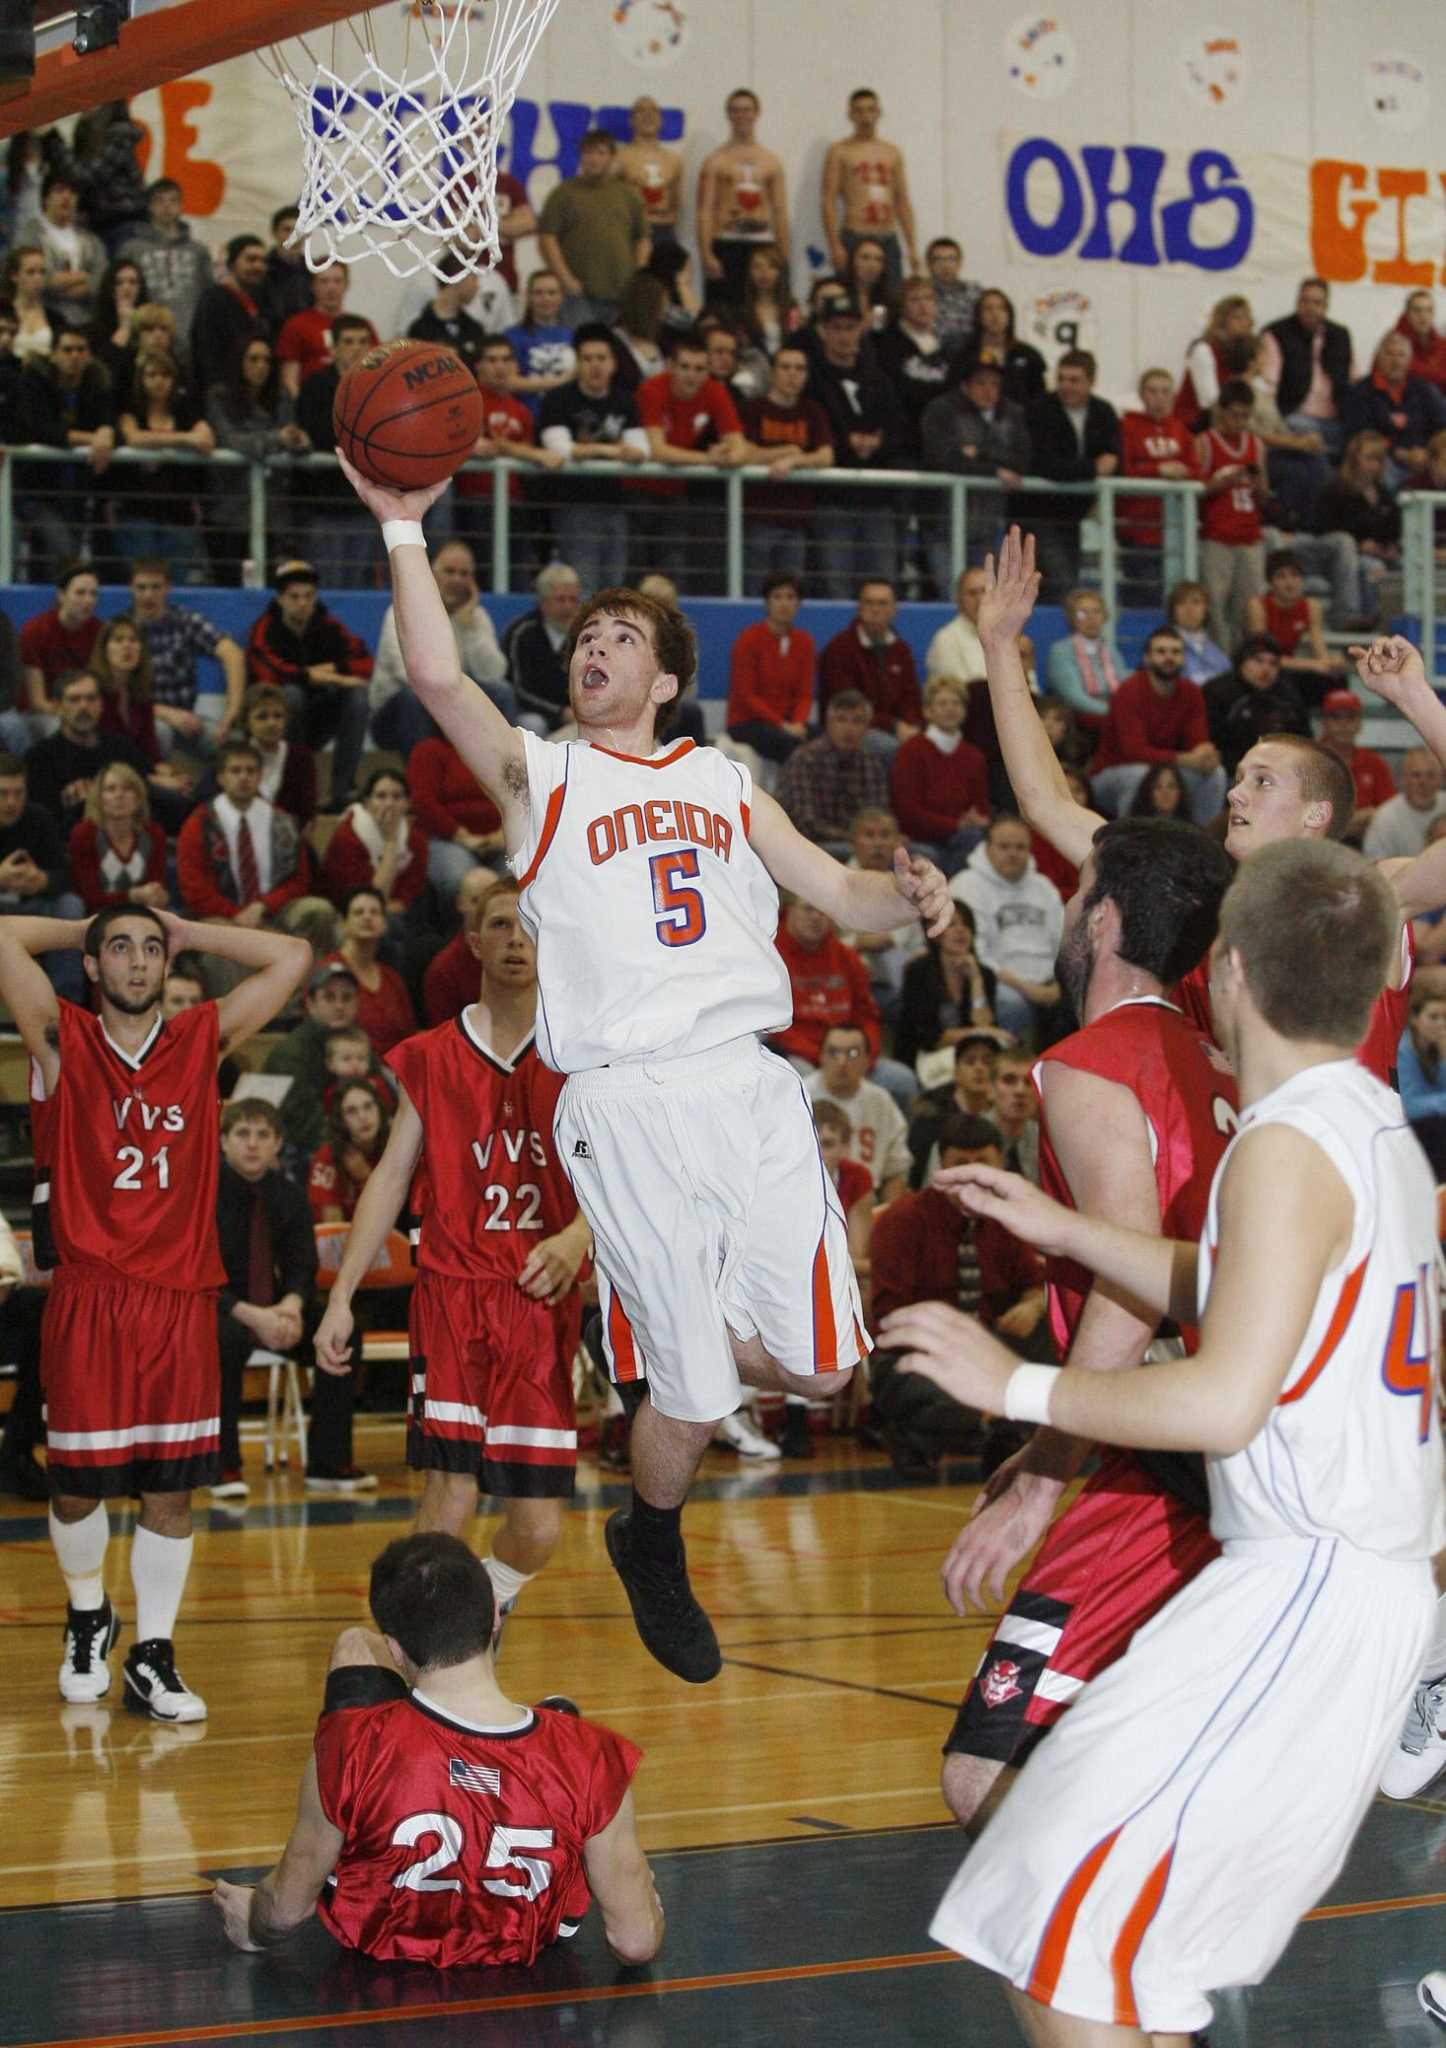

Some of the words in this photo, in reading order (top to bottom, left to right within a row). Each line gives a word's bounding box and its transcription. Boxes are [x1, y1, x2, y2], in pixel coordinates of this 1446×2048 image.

[1006, 137, 1254, 271] OHS
[1310, 159, 1446, 288] GI
[586, 800, 733, 866] ONEIDA
[648, 847, 707, 948] 5
[113, 1097, 184, 1131] VVS
[113, 1146, 169, 1190] 21
[471, 1129, 548, 1170] VVS
[484, 1184, 544, 1230] 22
[390, 1812, 554, 1902] 25
